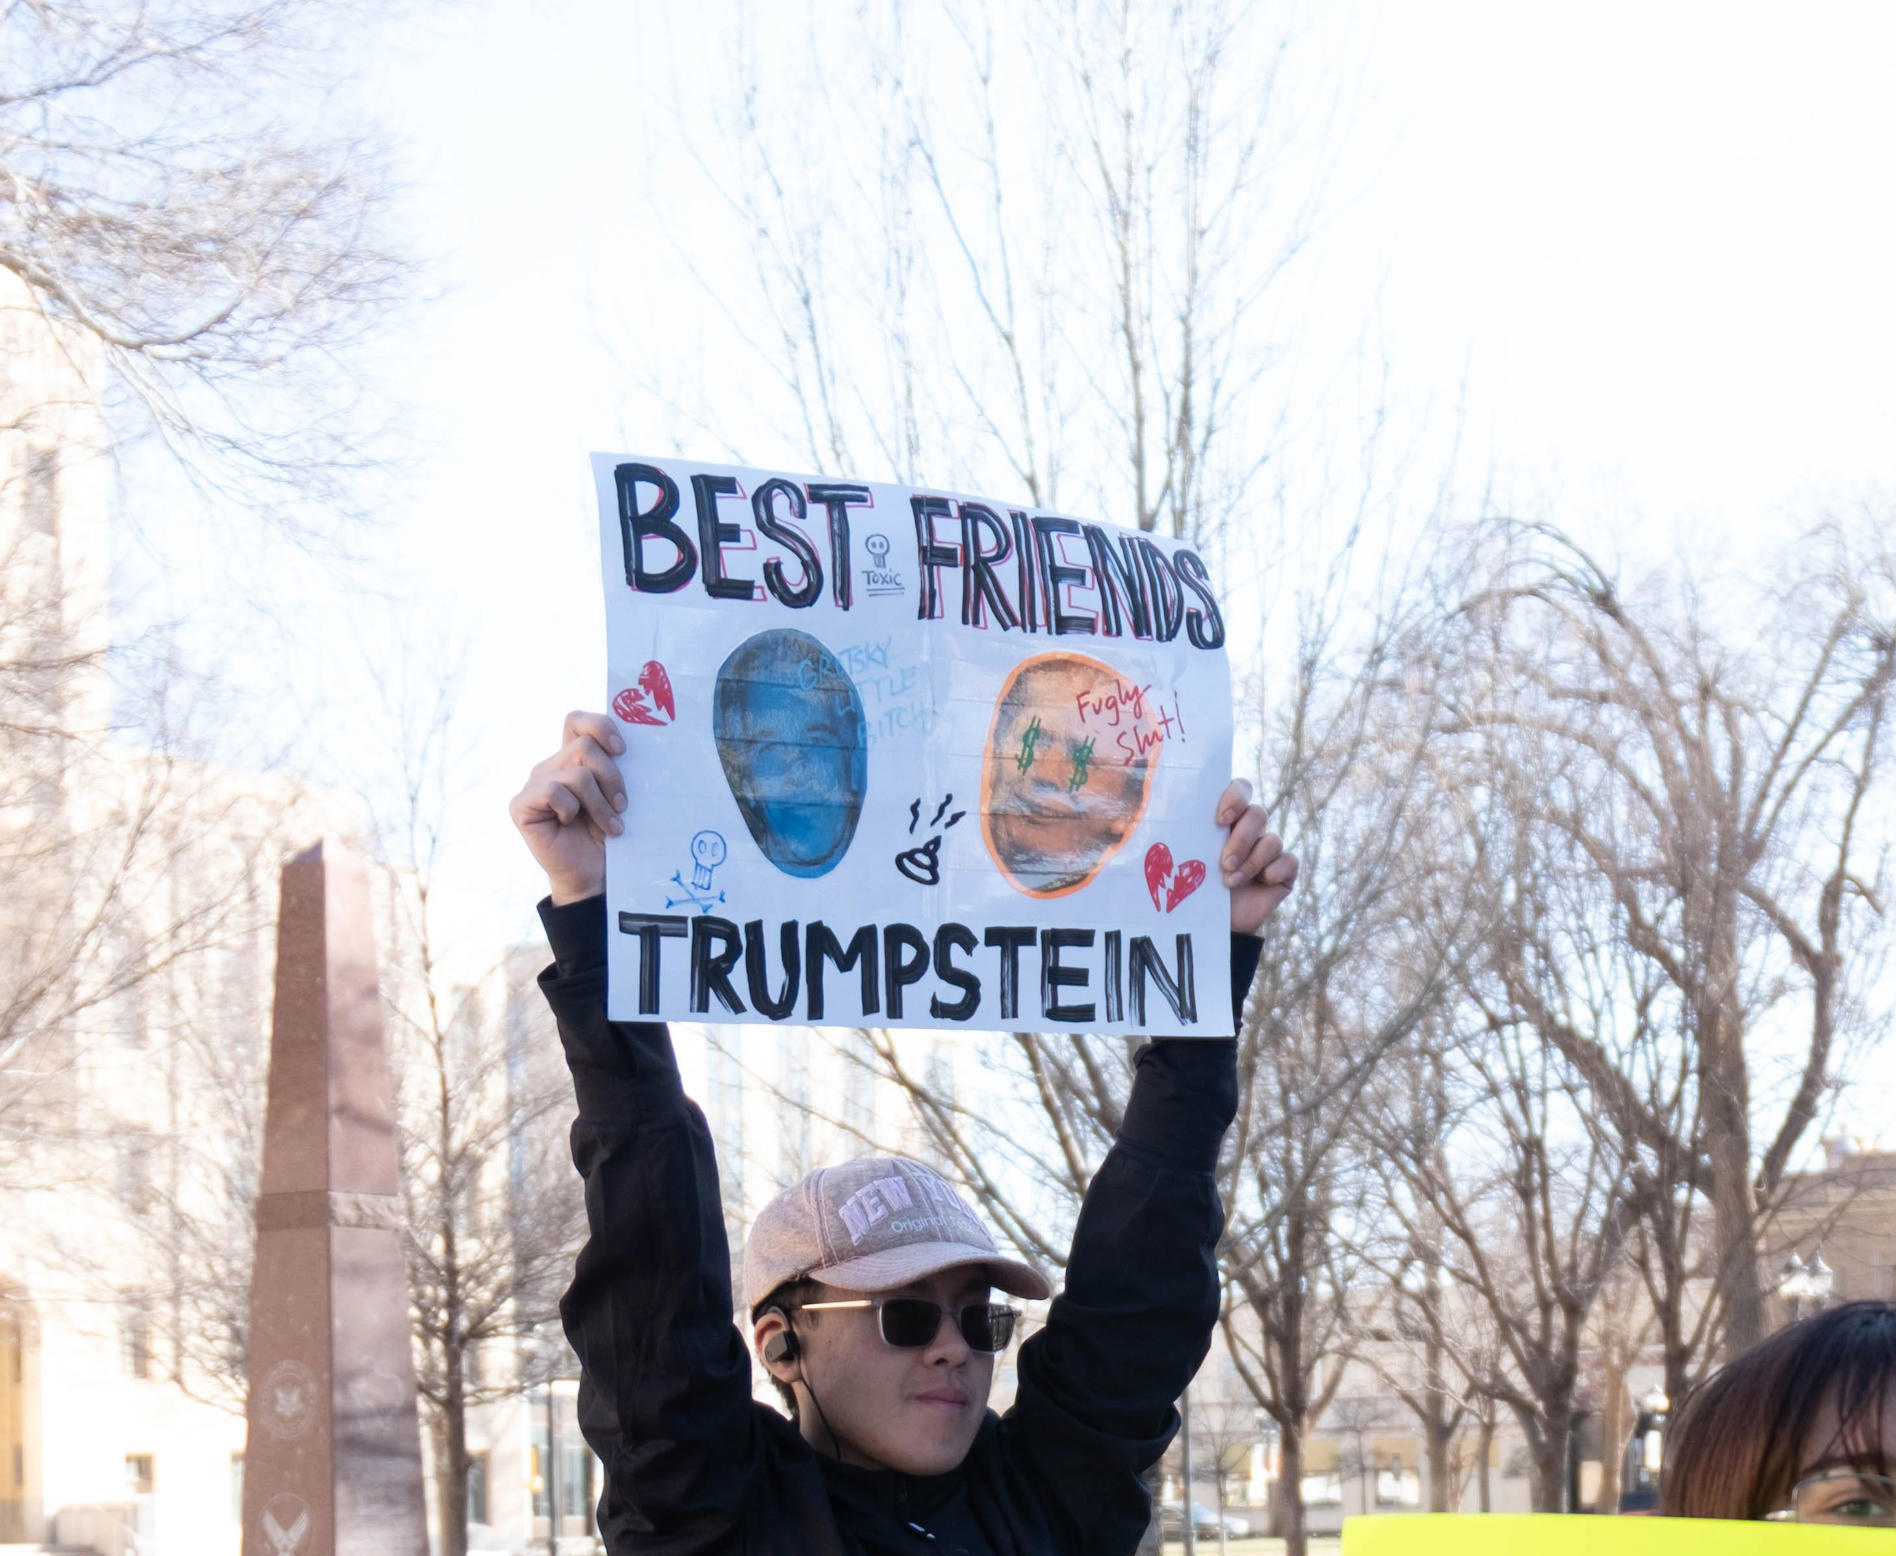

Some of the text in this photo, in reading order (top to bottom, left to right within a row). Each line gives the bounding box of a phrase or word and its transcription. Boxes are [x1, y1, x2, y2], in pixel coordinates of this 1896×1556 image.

[614, 462, 1225, 650] BEST FRIENDS
[1076, 678, 1152, 727] Fugly
[1116, 690, 1186, 767] Slut!
[618, 911, 1199, 1027] TRUMPSTEIN
[838, 1175, 913, 1247] NEW
